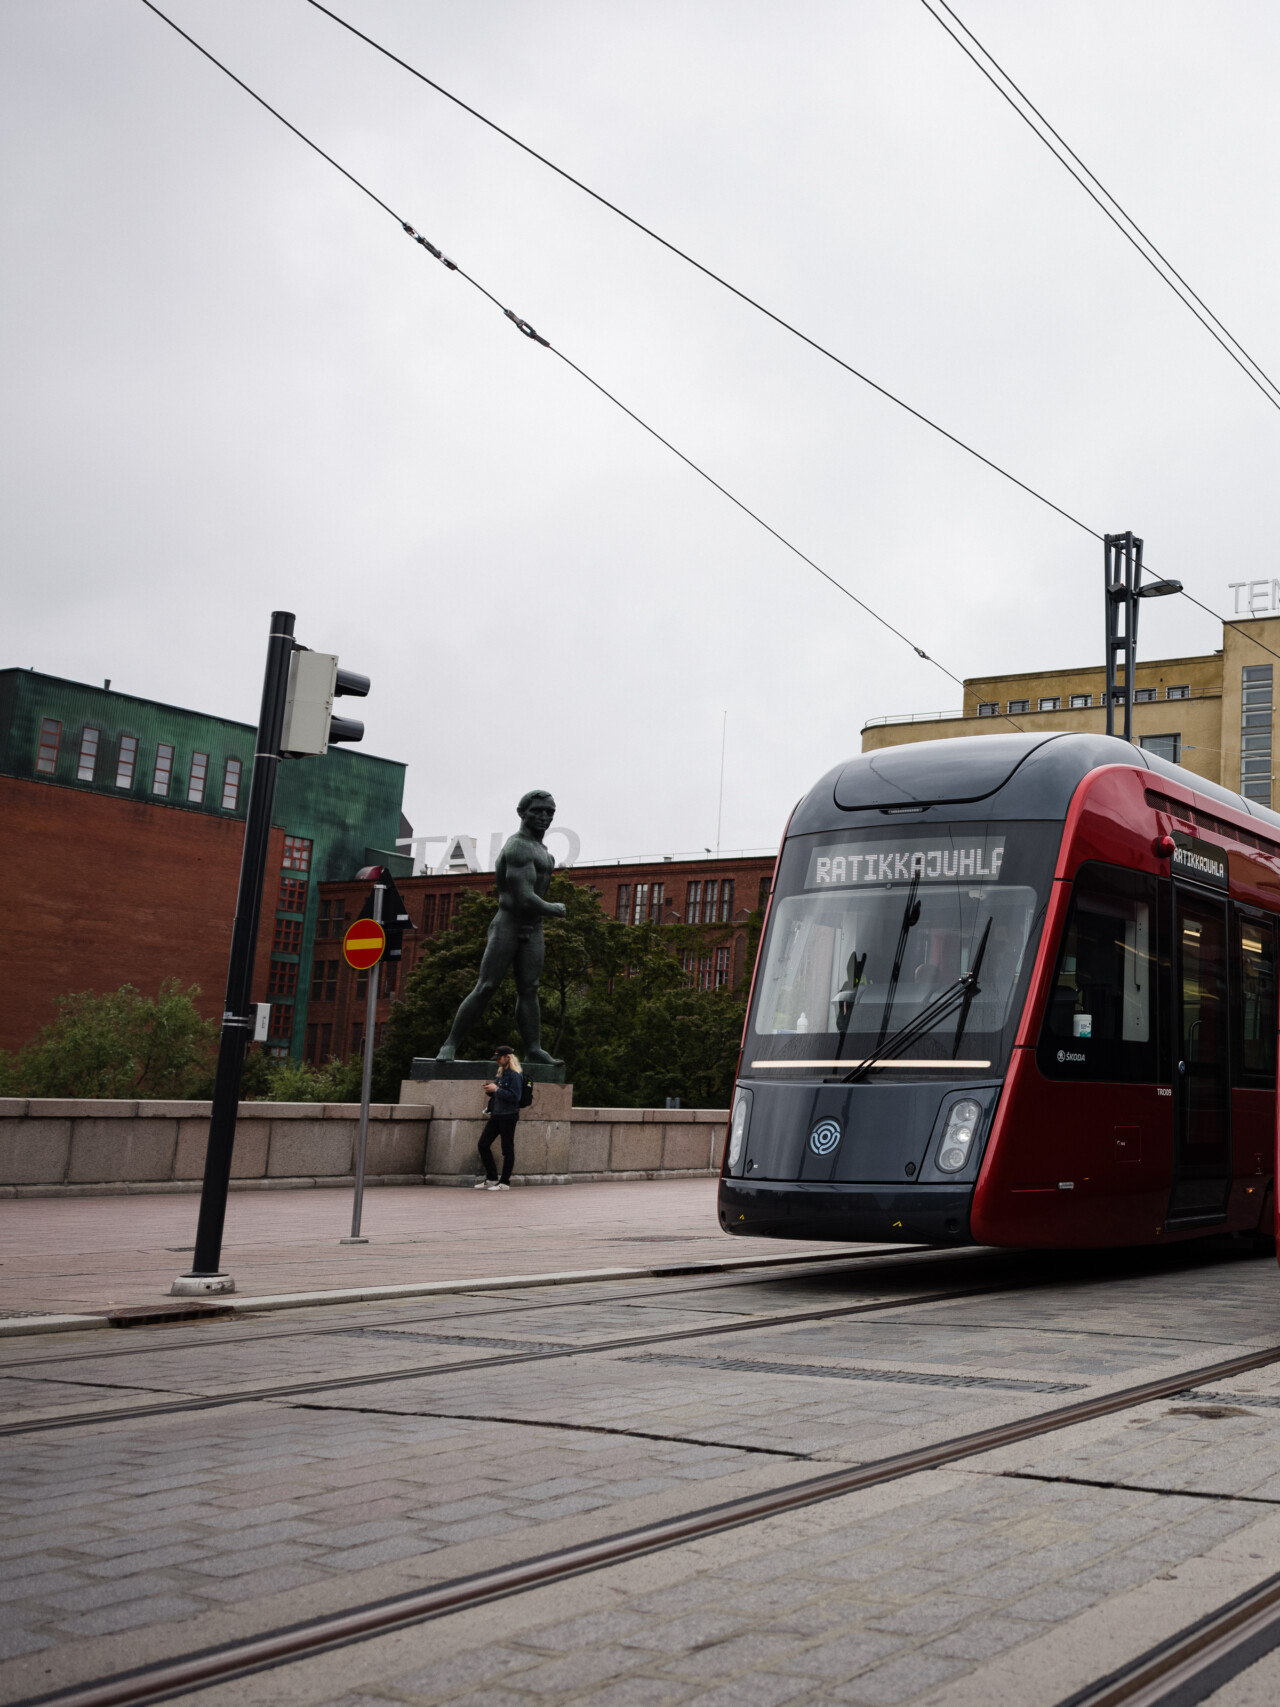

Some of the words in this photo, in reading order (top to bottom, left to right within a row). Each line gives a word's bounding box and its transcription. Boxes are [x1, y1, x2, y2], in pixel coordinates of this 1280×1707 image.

[396, 827, 581, 877] TAO
[816, 847, 1004, 883] RATIKKAJUHLA
[1173, 847, 1224, 878] RATIKKAJUHLA
[1066, 1052, 1086, 1062] ŠKODA
